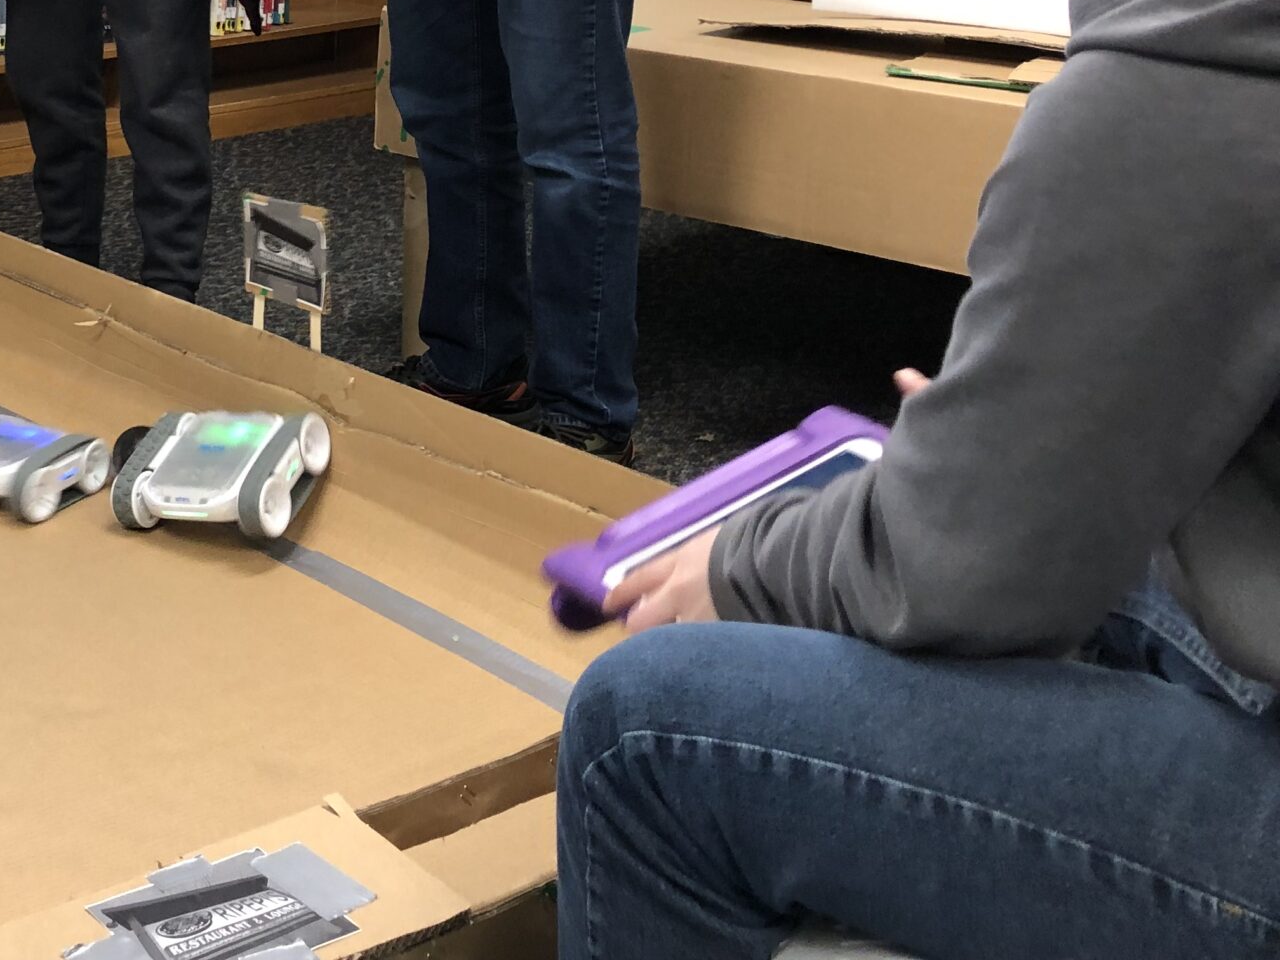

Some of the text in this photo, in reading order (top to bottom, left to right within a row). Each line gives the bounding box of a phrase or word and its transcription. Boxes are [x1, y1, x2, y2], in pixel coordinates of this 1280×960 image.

[169, 902, 305, 957] RESTAURANT & LOUNGE
